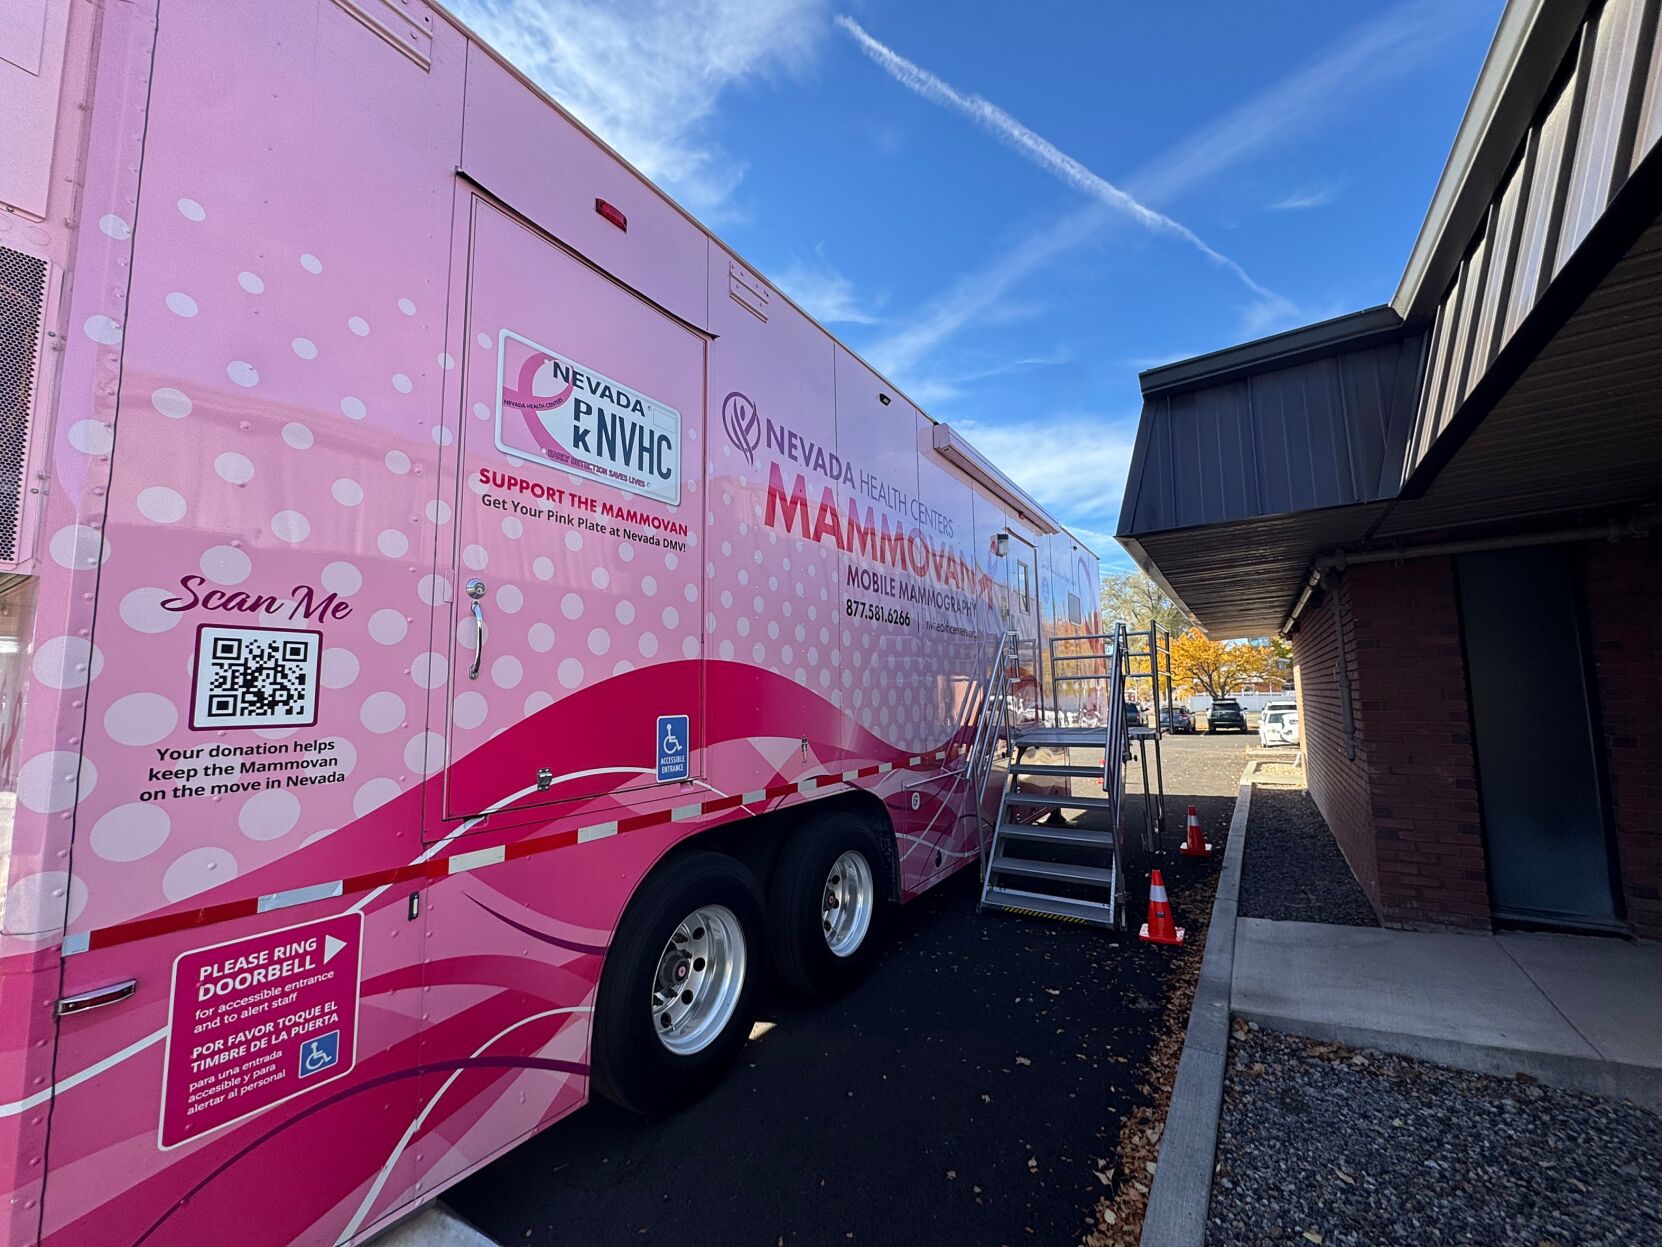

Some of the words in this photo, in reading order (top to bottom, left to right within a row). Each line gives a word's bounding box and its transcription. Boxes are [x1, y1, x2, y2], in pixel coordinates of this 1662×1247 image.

[503, 399, 526, 409] NEVADA
[545, 398, 565, 409] CENTERS
[552, 360, 646, 417] NEVADA
[596, 407, 673, 480] NVHC
[608, 469, 629, 483] SAVES
[628, 475, 646, 488] LIVES
[766, 417, 856, 490] NEVADA
[859, 469, 908, 517] HEALTH
[910, 498, 954, 538] CENTERS
[479, 467, 565, 505] SUPPORT
[569, 492, 597, 514] THE
[600, 501, 688, 537] MAMMOVAN
[481, 493, 508, 511] Get
[511, 500, 544, 522] Your
[547, 509, 575, 527] Pink
[577, 516, 607, 535] Plate
[609, 526, 621, 538] at
[623, 528, 661, 548] Nevada
[662, 536, 687, 553] DMV!
[764, 460, 977, 595] MAMMOVAN
[160, 574, 284, 614] Scan
[288, 584, 353, 624] Me
[846, 564, 896, 598] MOBILE
[899, 581, 977, 618] MAMMOGRAPHY
[846, 598, 911, 627] 877.581.6266
[148, 767, 198, 782] keep
[203, 763, 235, 777] the
[240, 755, 338, 775] Mammovan
[156, 748, 204, 762] Your
[208, 741, 289, 759] donation
[293, 739, 335, 753] helps
[660, 754, 686, 765] ACCESSIBLE
[661, 763, 684, 774] ENTRANCE
[139, 788, 166, 802] on
[172, 784, 205, 799] the
[210, 779, 261, 796] move
[266, 776, 281, 789] in
[286, 771, 345, 788] Nevada
[198, 955, 316, 1002] DOORBELL
[199, 951, 269, 981] PLEASE
[273, 937, 318, 961] RING
[193, 1017, 221, 1034] and
[223, 1013, 238, 1024] to
[240, 1003, 269, 1019] alert
[271, 992, 299, 1009] staff
[195, 1008, 214, 1021] for
[218, 985, 282, 1014] accessible
[284, 970, 335, 993] entrance
[191, 1047, 246, 1073] TIMBRE
[250, 1038, 267, 1052] DE
[271, 1031, 288, 1044] LA
[290, 1013, 339, 1038] PUERTA
[192, 1040, 224, 1059] POR
[227, 1023, 275, 1049] FAVOR
[277, 1005, 322, 1029] TOQUE
[324, 1000, 339, 1012] EL
[186, 1094, 225, 1116] alertar
[227, 1087, 239, 1100] al
[240, 1068, 286, 1095] personal
[188, 1076, 241, 1103] accesible
[243, 1073, 251, 1085] y
[252, 1063, 276, 1080] para
[189, 1077, 215, 1093] para
[218, 1066, 239, 1079] una
[242, 1049, 283, 1071] entrada
